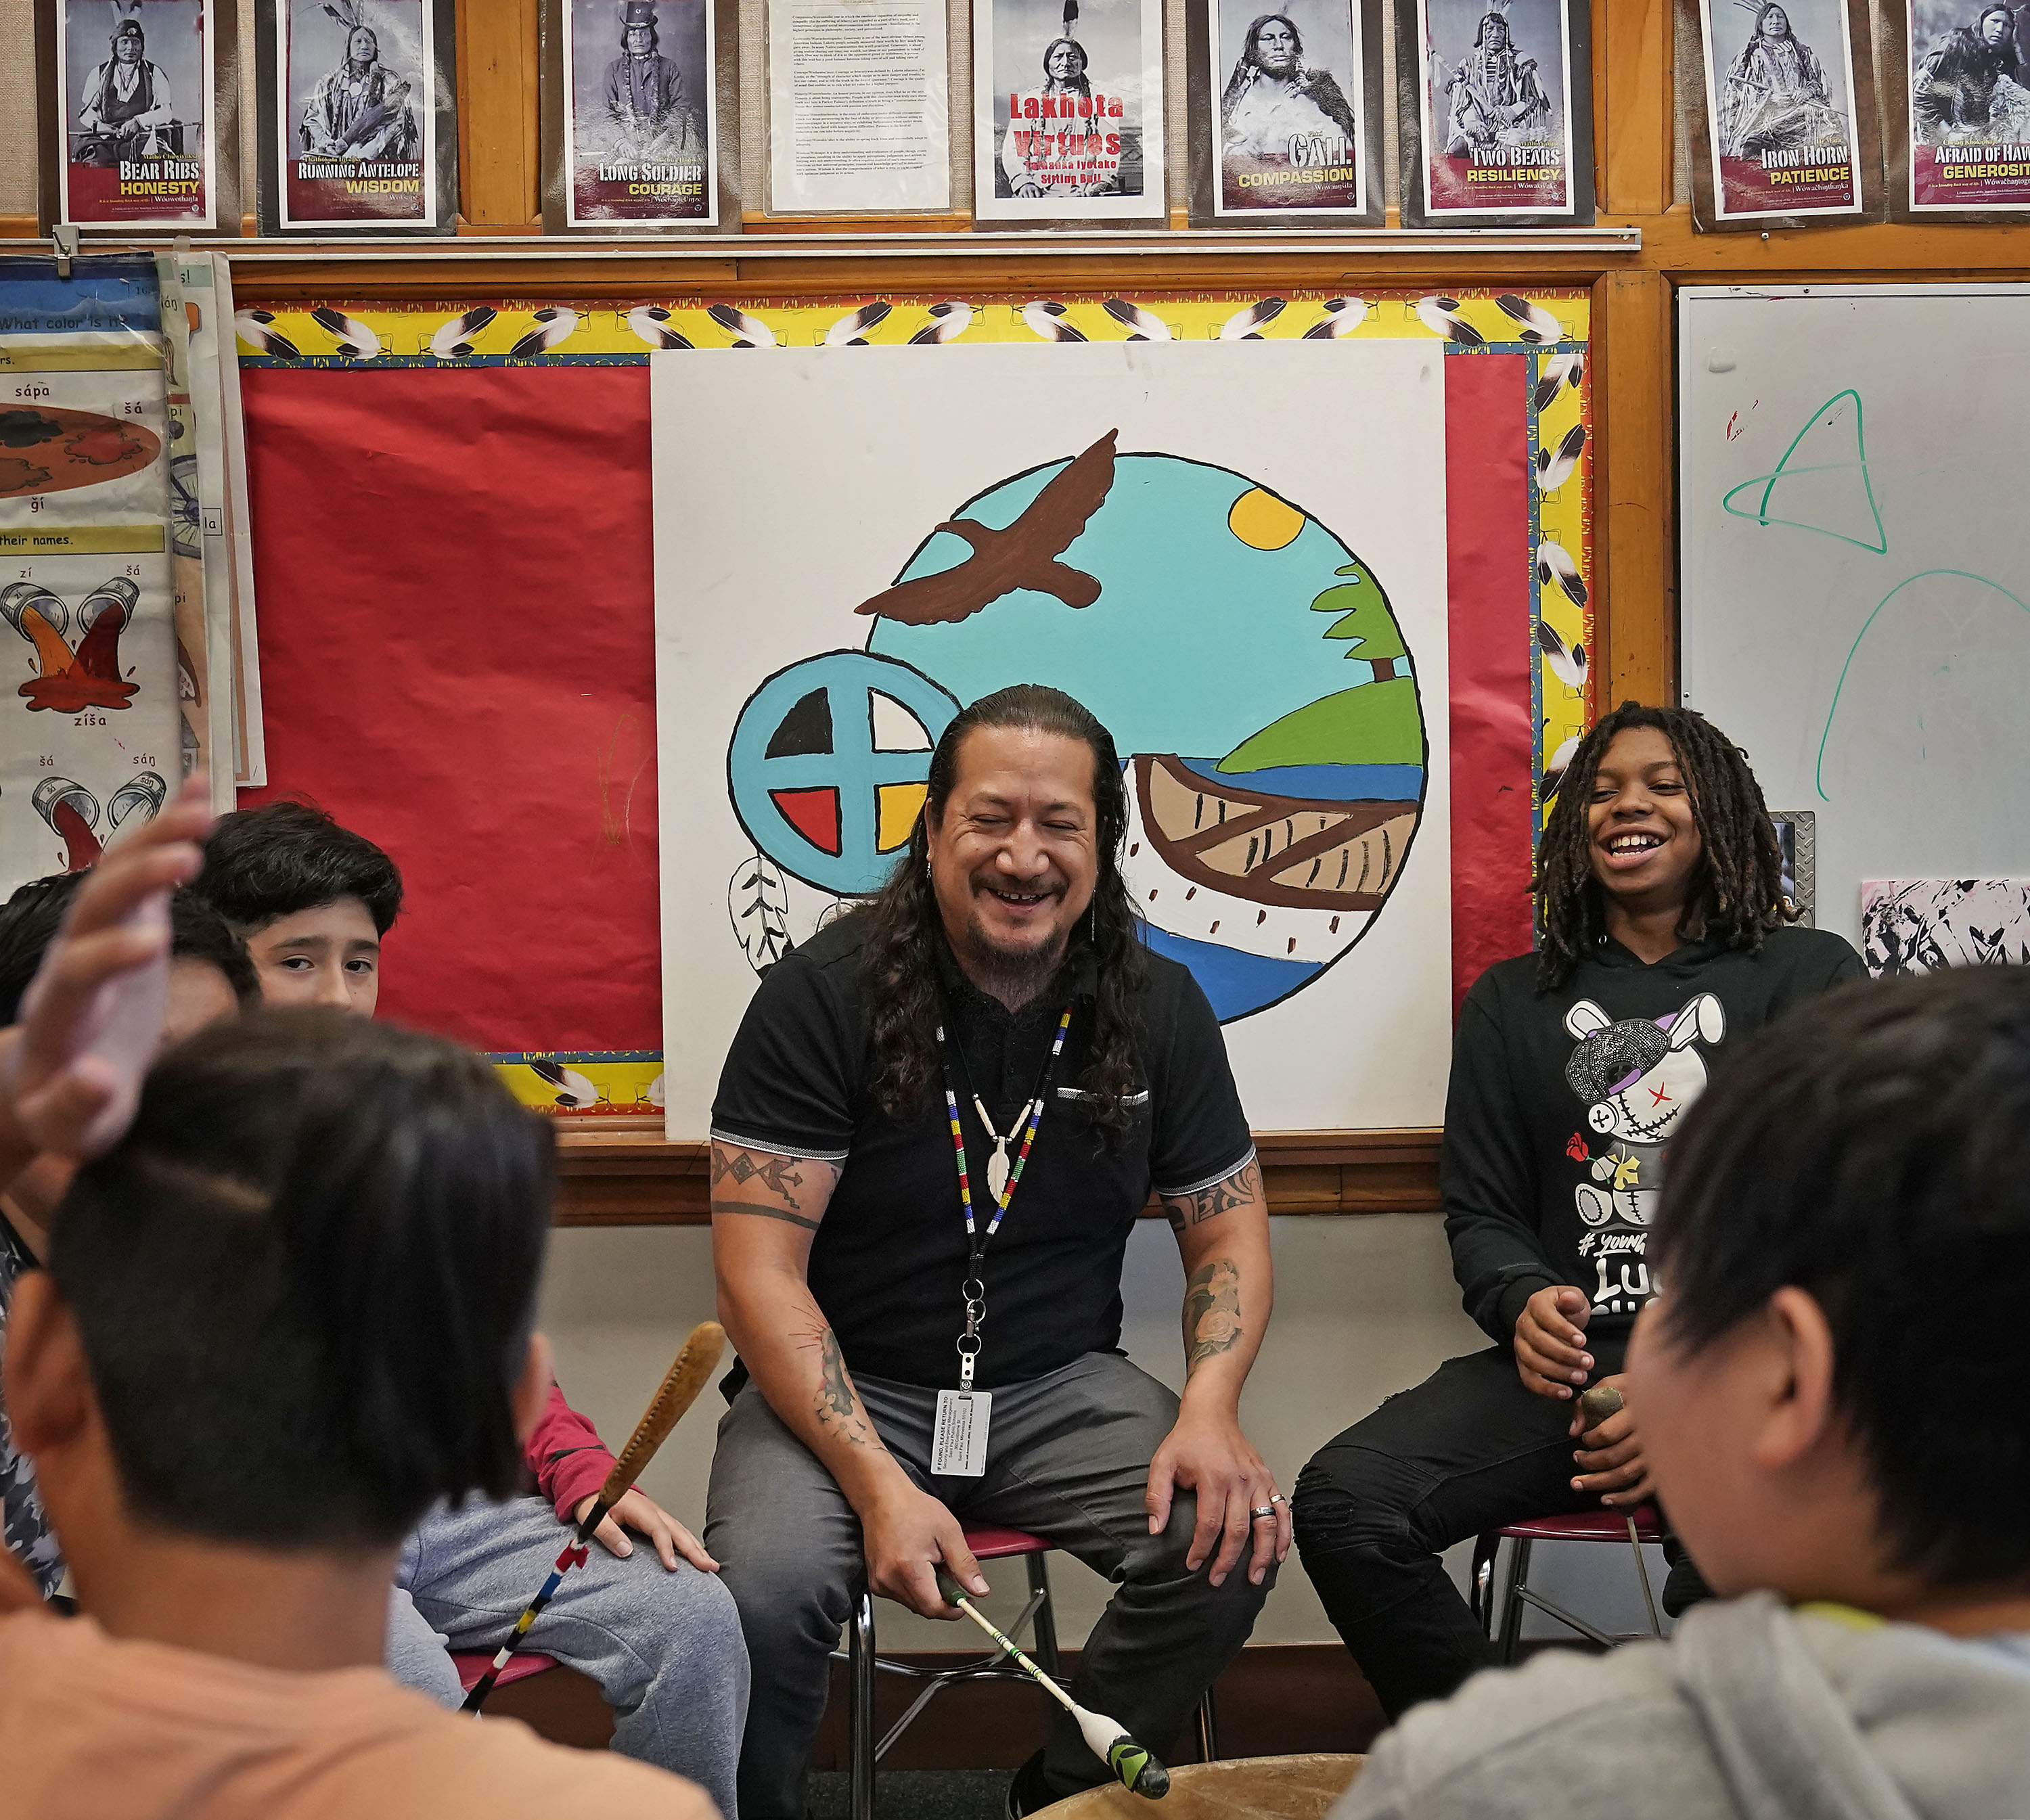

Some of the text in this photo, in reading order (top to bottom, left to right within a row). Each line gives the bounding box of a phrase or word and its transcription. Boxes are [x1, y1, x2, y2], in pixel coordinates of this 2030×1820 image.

[1010, 93, 1123, 118] Lakhota
[1014, 131, 1121, 157] Virtues
[1288, 133, 1352, 168] GALL
[1470, 147, 1560, 166] TWO BEARS
[1761, 145, 1848, 169] IRON HORN
[1935, 145, 1983, 164] AFRAID
[1985, 147, 2001, 162] OF
[120, 160, 200, 180] BEAR RIBS
[298, 162, 420, 179] RUNNING ANTELOPE
[600, 162, 702, 181] LONG SOLDIER
[1238, 167, 1353, 188] COMPASSION
[1467, 169, 1561, 182] RESILIENCY
[1770, 166, 1849, 185] PATIENCE
[1943, 163, 2030, 179] GENEROSIT
[1041, 173, 1102, 185] Sitting Bull
[120, 181, 200, 195] HONESTY
[346, 180, 420, 194] WISDOM
[629, 183, 702, 195] COURAGE
[47, 316, 83, 329] color
[90, 315, 101, 327] is
[0, 357, 15, 365] rs.
[15, 384, 50, 399] sápa
[125, 401, 143, 414] šá
[0, 534, 73, 545] their names.
[20, 567, 32, 578] zí
[126, 564, 141, 576] šá
[74, 714, 107, 726] zíša
[39, 755, 54, 767] šá
[133, 752, 156, 767] sáŋ
